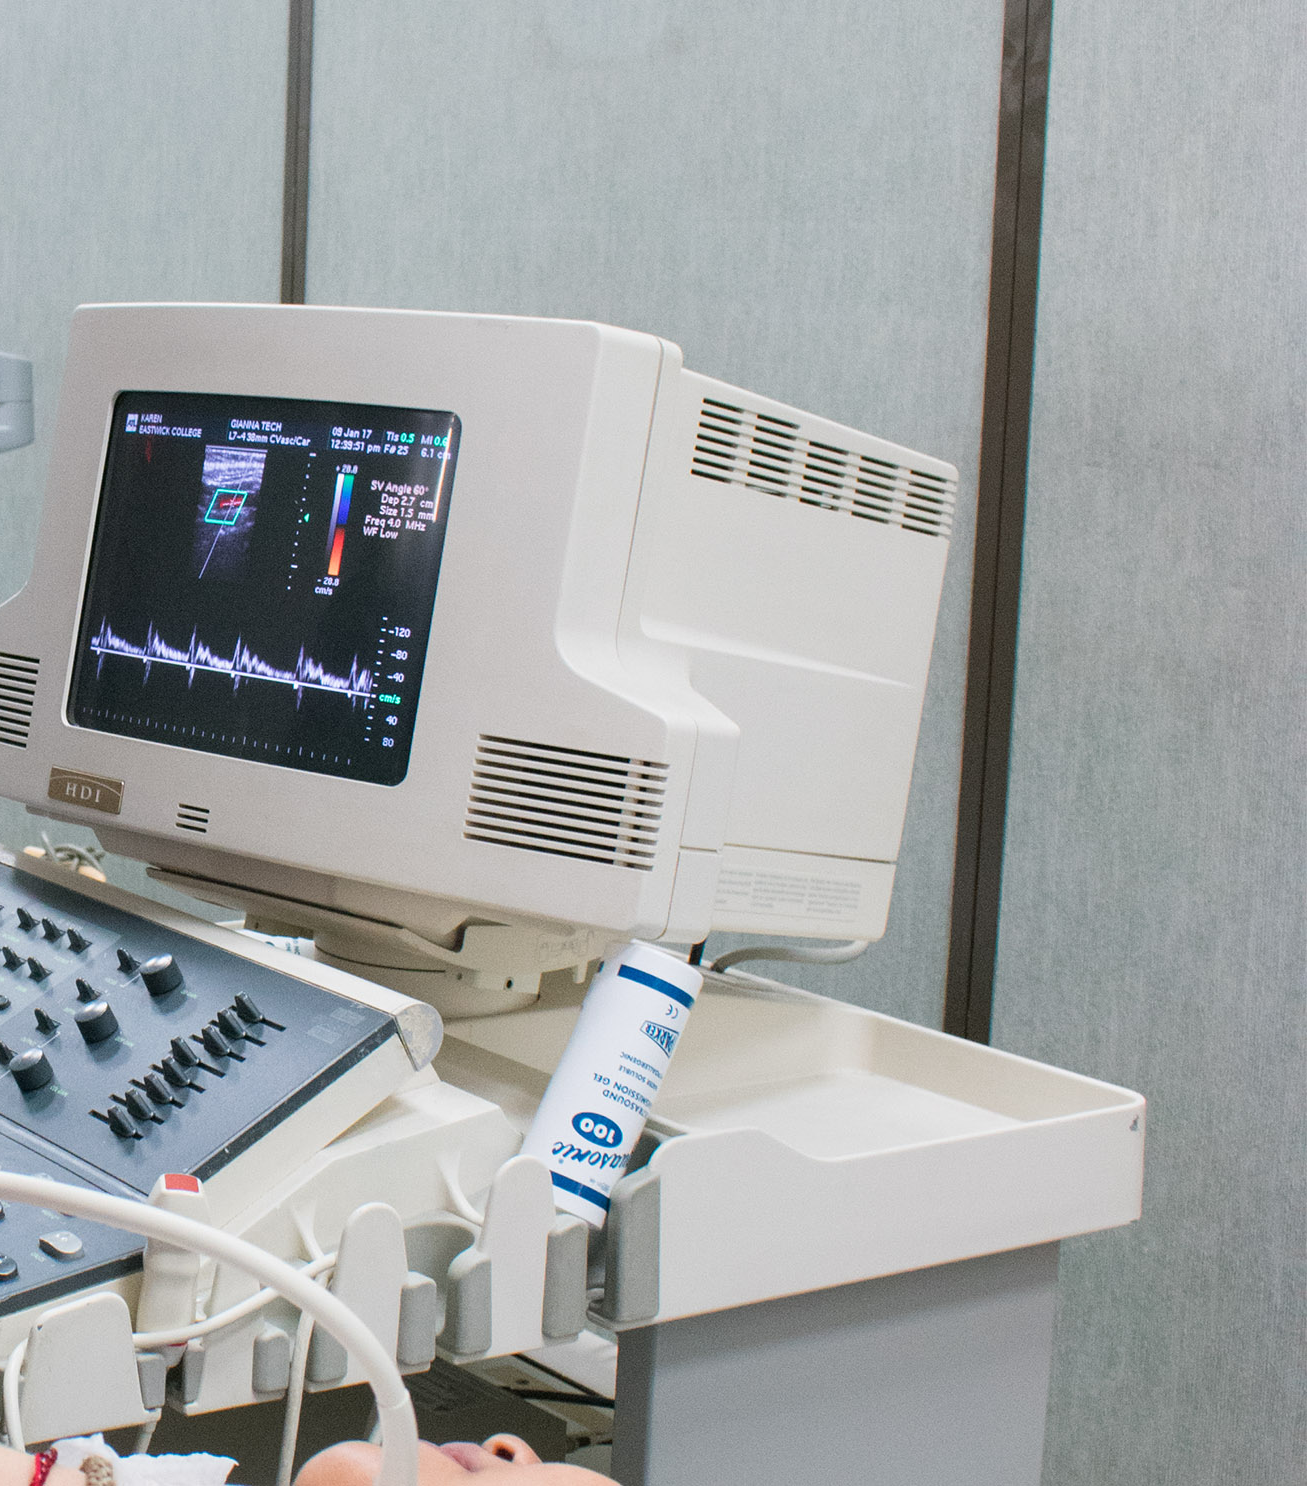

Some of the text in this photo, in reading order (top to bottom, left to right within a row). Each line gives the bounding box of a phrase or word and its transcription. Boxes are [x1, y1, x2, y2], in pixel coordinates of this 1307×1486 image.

[141, 413, 162, 424] KAREN
[230, 418, 282, 432] GIANNA TECH
[139, 424, 202, 438] EASTWICK COLLEGE
[343, 427, 360, 438] Jan
[361, 428, 372, 439] 17
[399, 432, 415, 444] 0.5
[366, 443, 381, 454] pm
[397, 444, 409, 456] 25
[420, 447, 434, 458] 6.1
[370, 479, 385, 492] SV
[384, 481, 412, 496] Angle
[380, 492, 434, 509] Dep 2.7 cm
[379, 504, 435, 521] Size 1.5 mm
[364, 514, 427, 532] Freq 4.0 MHz
[362, 525, 399, 540] WF Low
[314, 585, 333, 596] cm/s
[378, 692, 401, 705] cm/s
[385, 715, 398, 726] 40
[382, 736, 394, 748] 80
[65, 781, 101, 803] HDI
[593, 1072, 611, 1086] GEL
[579, 1117, 616, 1145] 100
